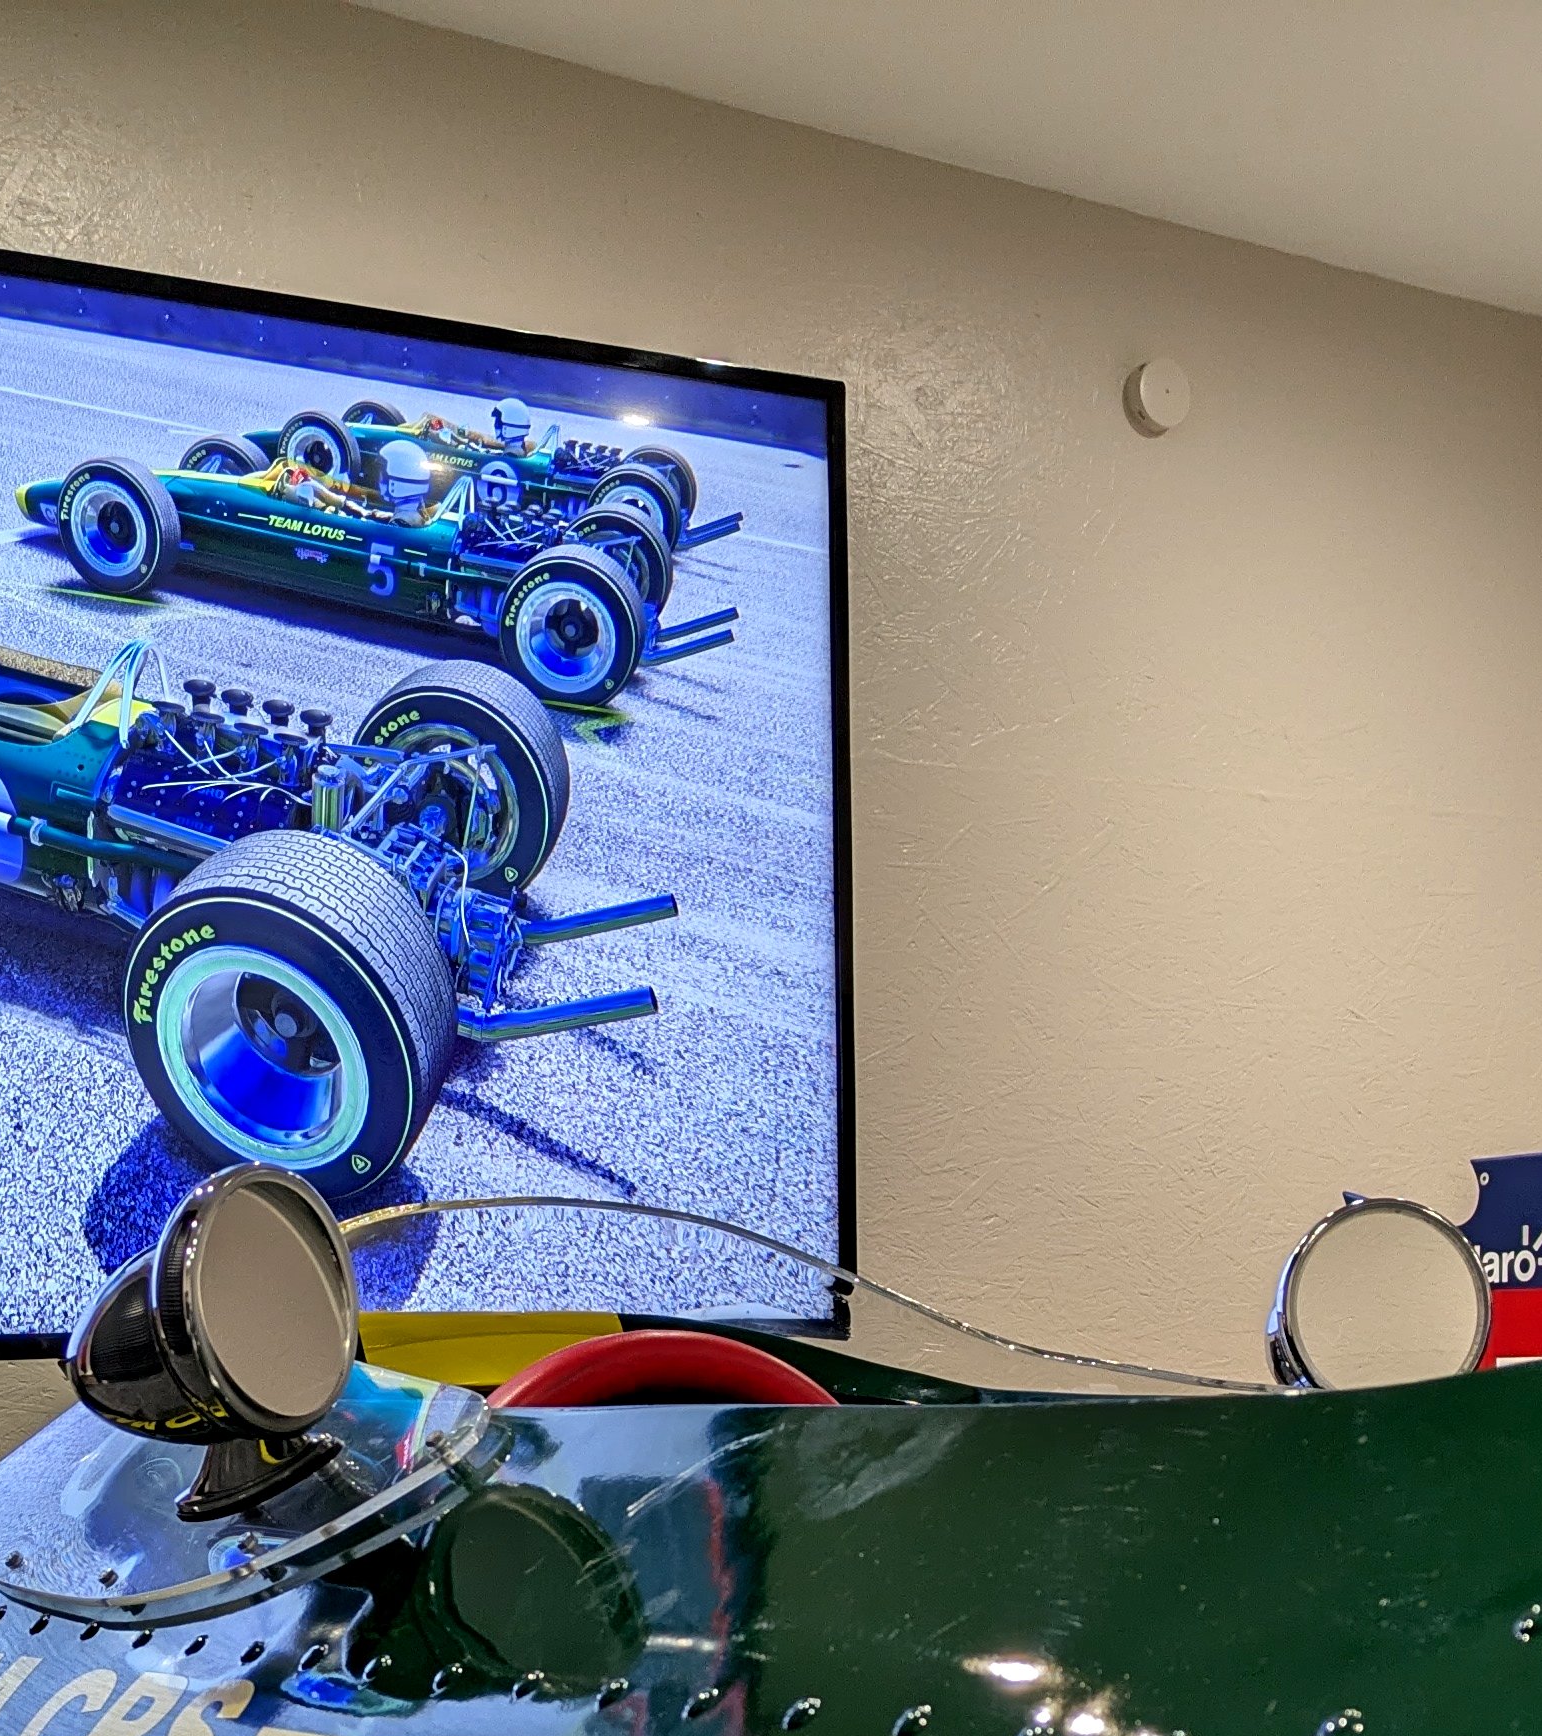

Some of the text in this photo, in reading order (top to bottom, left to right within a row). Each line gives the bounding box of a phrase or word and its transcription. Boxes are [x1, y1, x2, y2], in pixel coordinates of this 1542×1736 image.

[444, 454, 474, 468] LOTUS
[60, 472, 91, 521] Firestone
[267, 514, 346, 542] TEAM LOTUS
[367, 542, 395, 597] 5
[504, 572, 550, 627] Firestone
[369, 710, 420, 756] stone
[132, 923, 216, 1025] Firestone
[1474, 1245, 1536, 1283] aro
